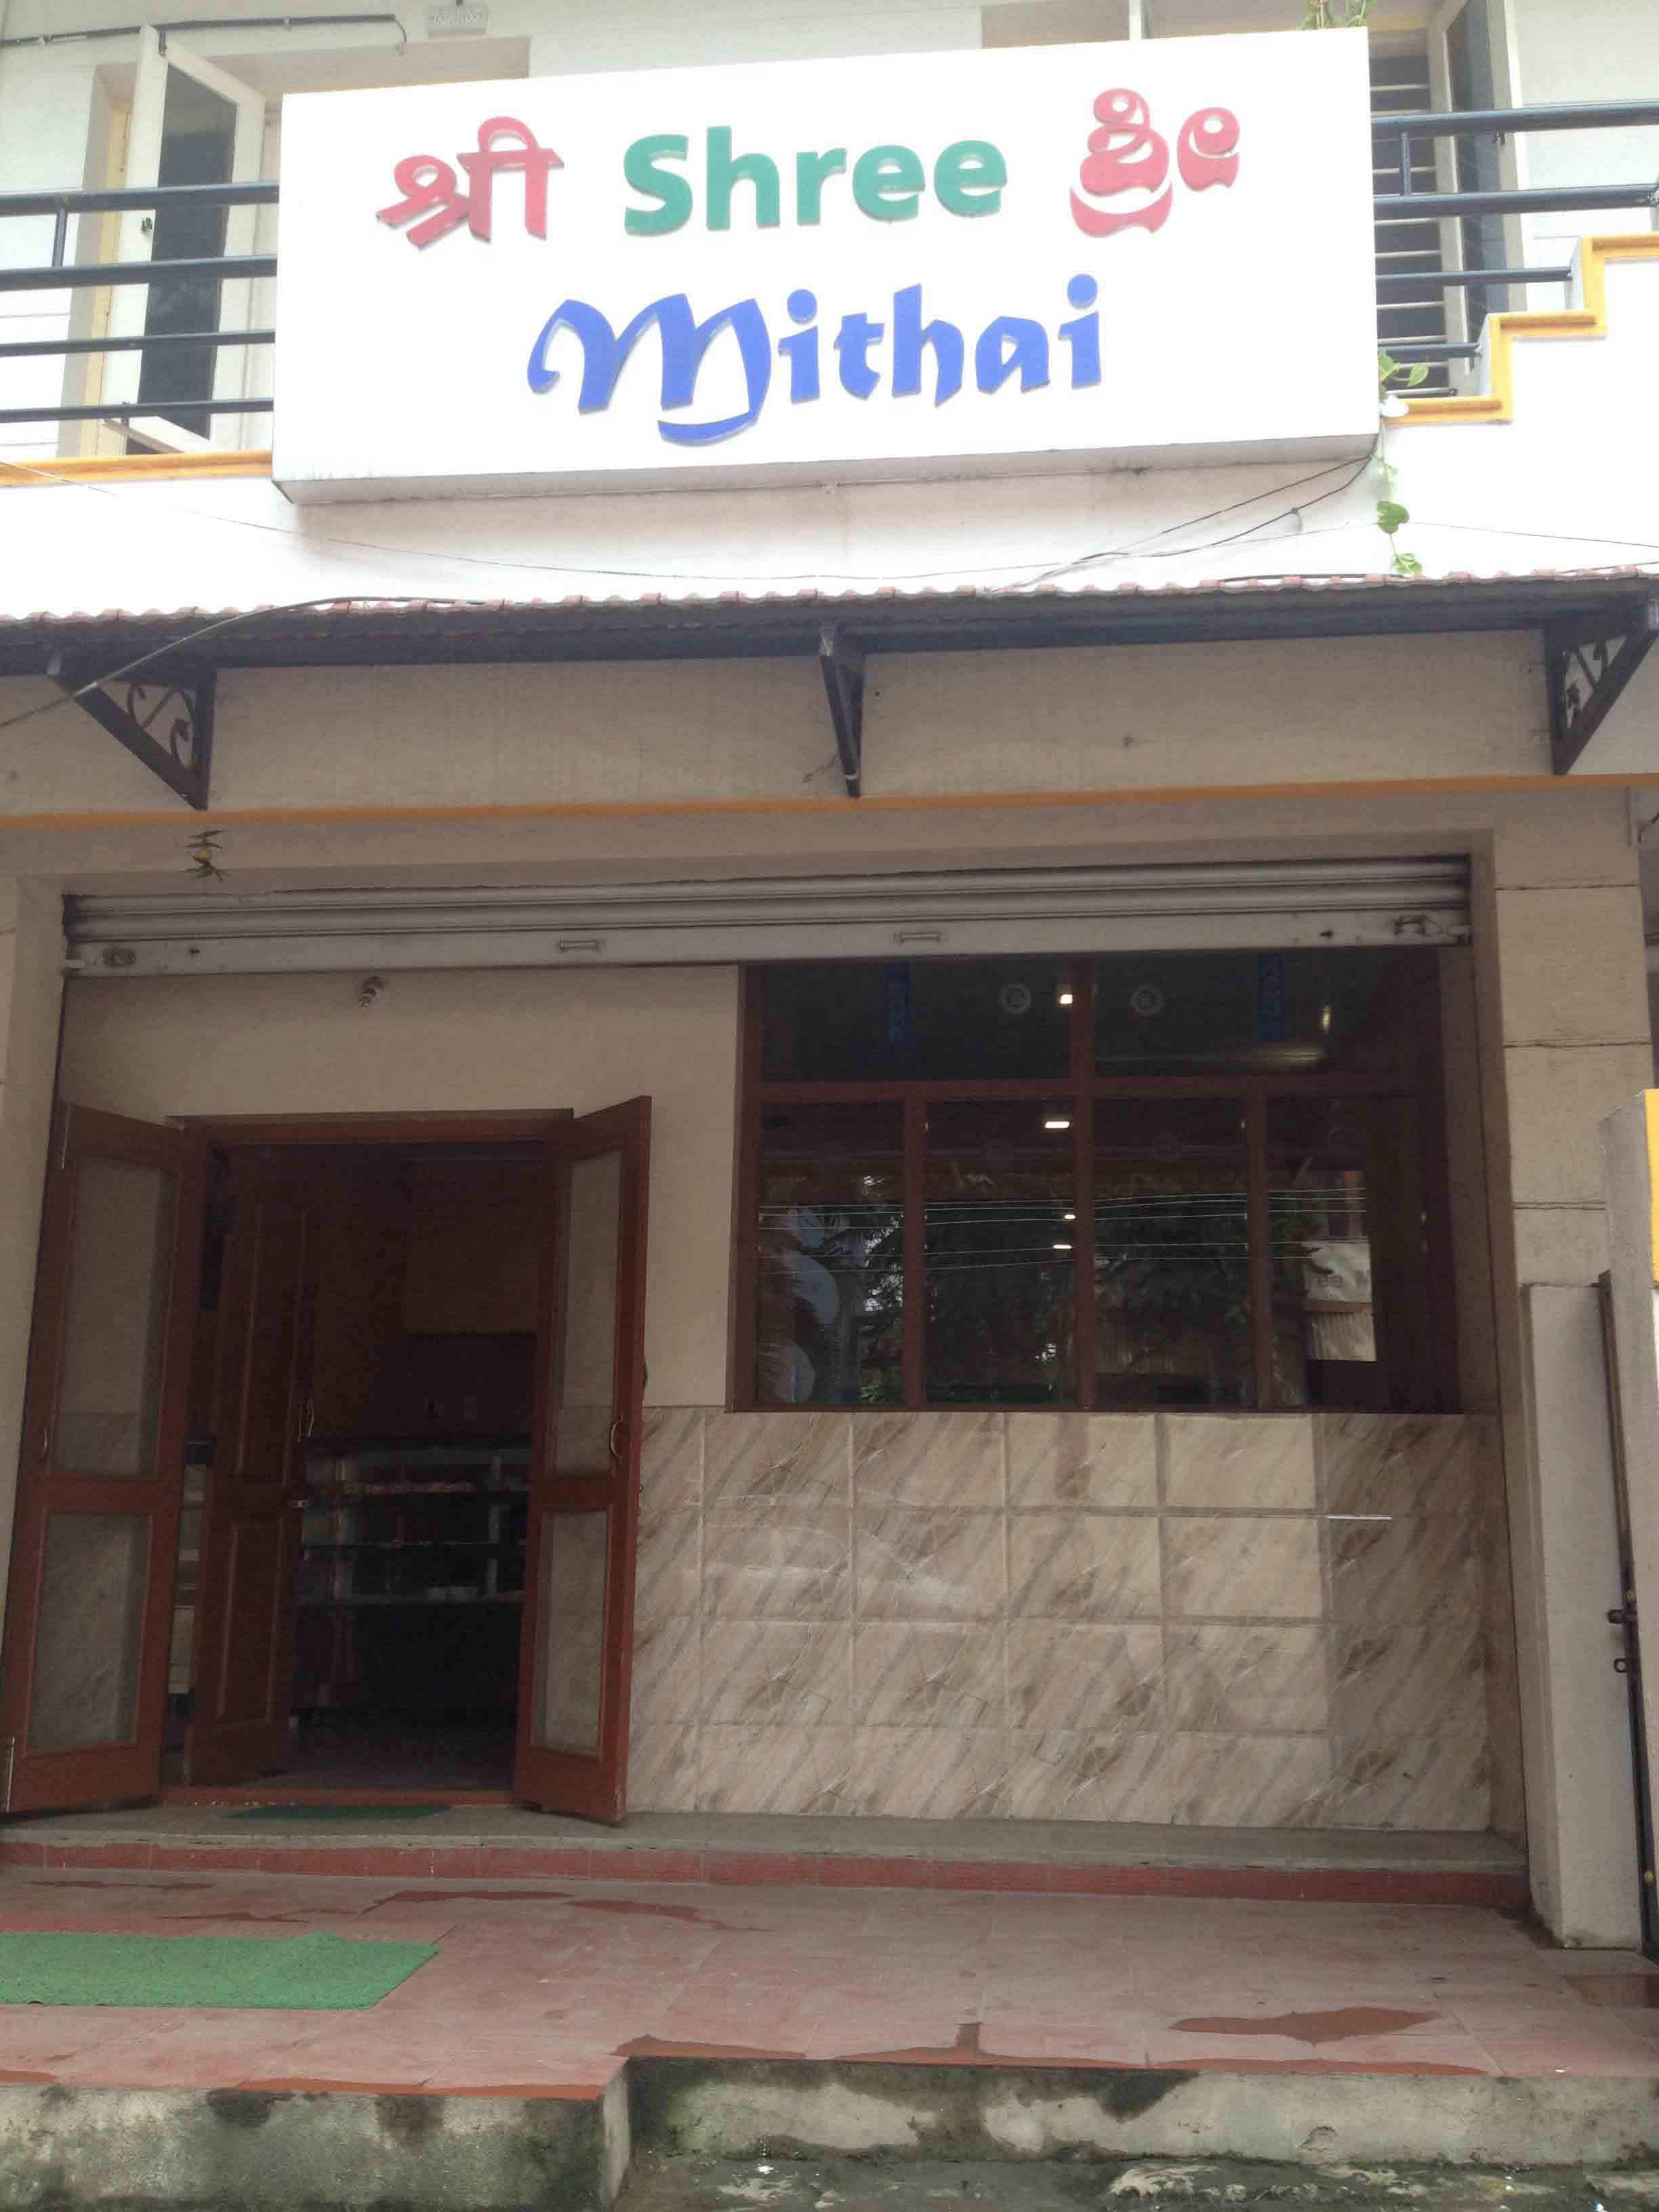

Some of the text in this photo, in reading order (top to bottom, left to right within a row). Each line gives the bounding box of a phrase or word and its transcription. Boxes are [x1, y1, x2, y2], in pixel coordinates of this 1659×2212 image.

[377, 116, 564, 248] श्री
[624, 125, 1007, 236] Shree
[527, 274, 1101, 445] Mithai
